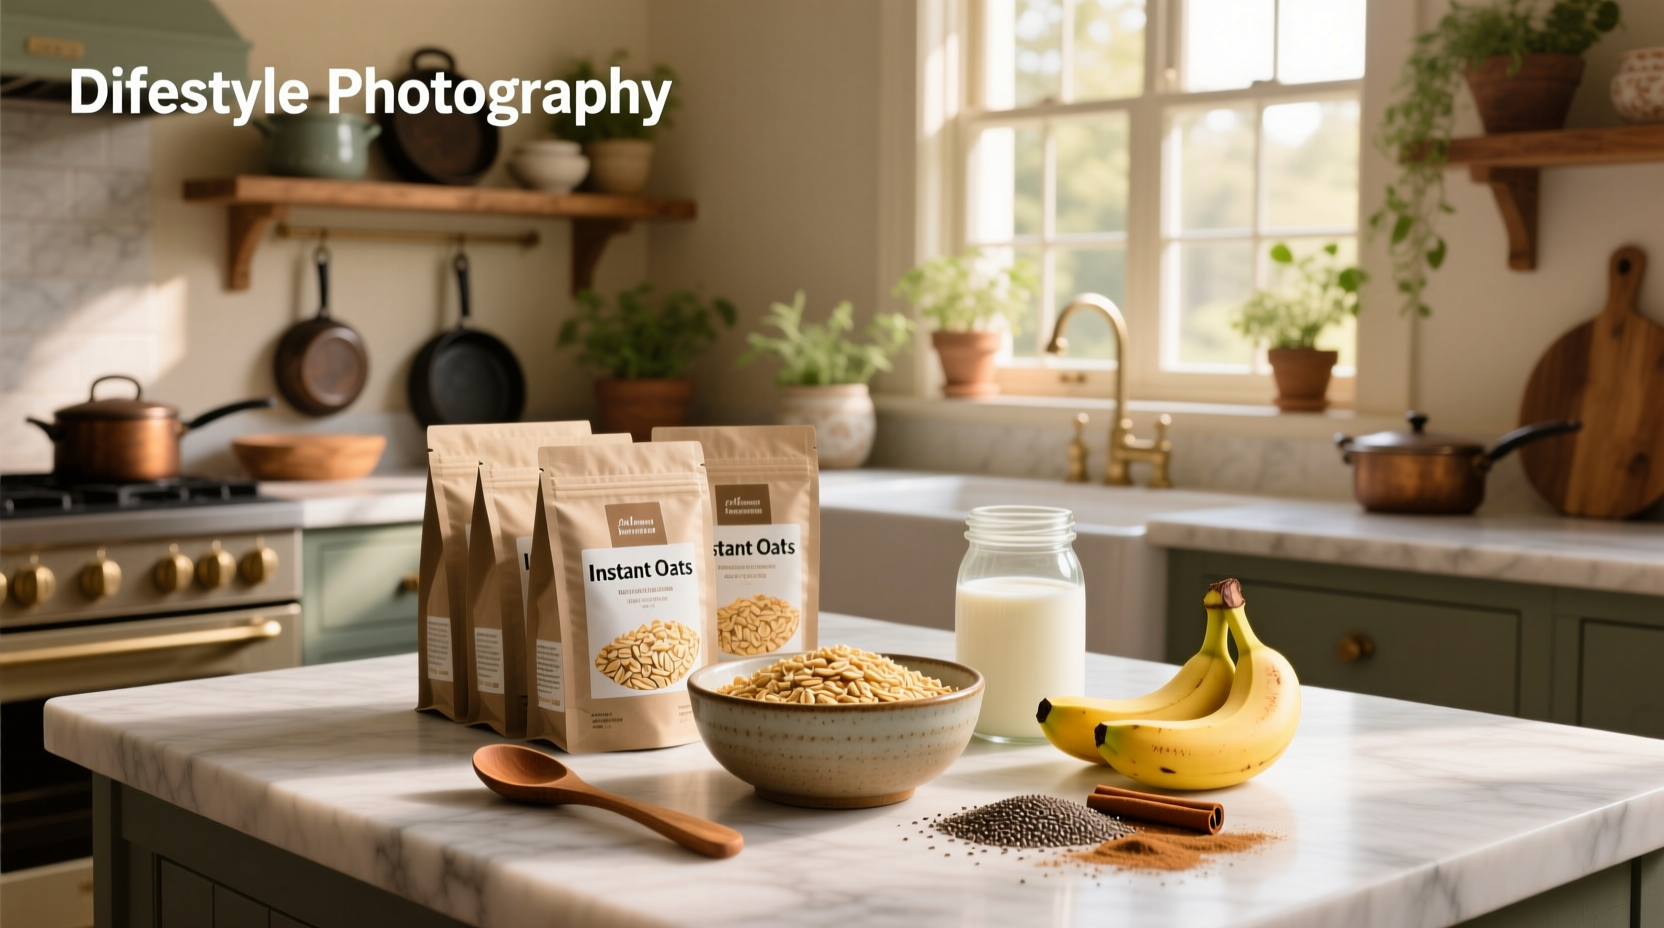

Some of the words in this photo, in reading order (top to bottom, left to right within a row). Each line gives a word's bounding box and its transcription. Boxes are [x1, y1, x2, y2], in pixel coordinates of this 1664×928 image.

[756, 538, 796, 556] Oats
[588, 562, 652, 582] Instant
[654, 559, 693, 577] Oats
